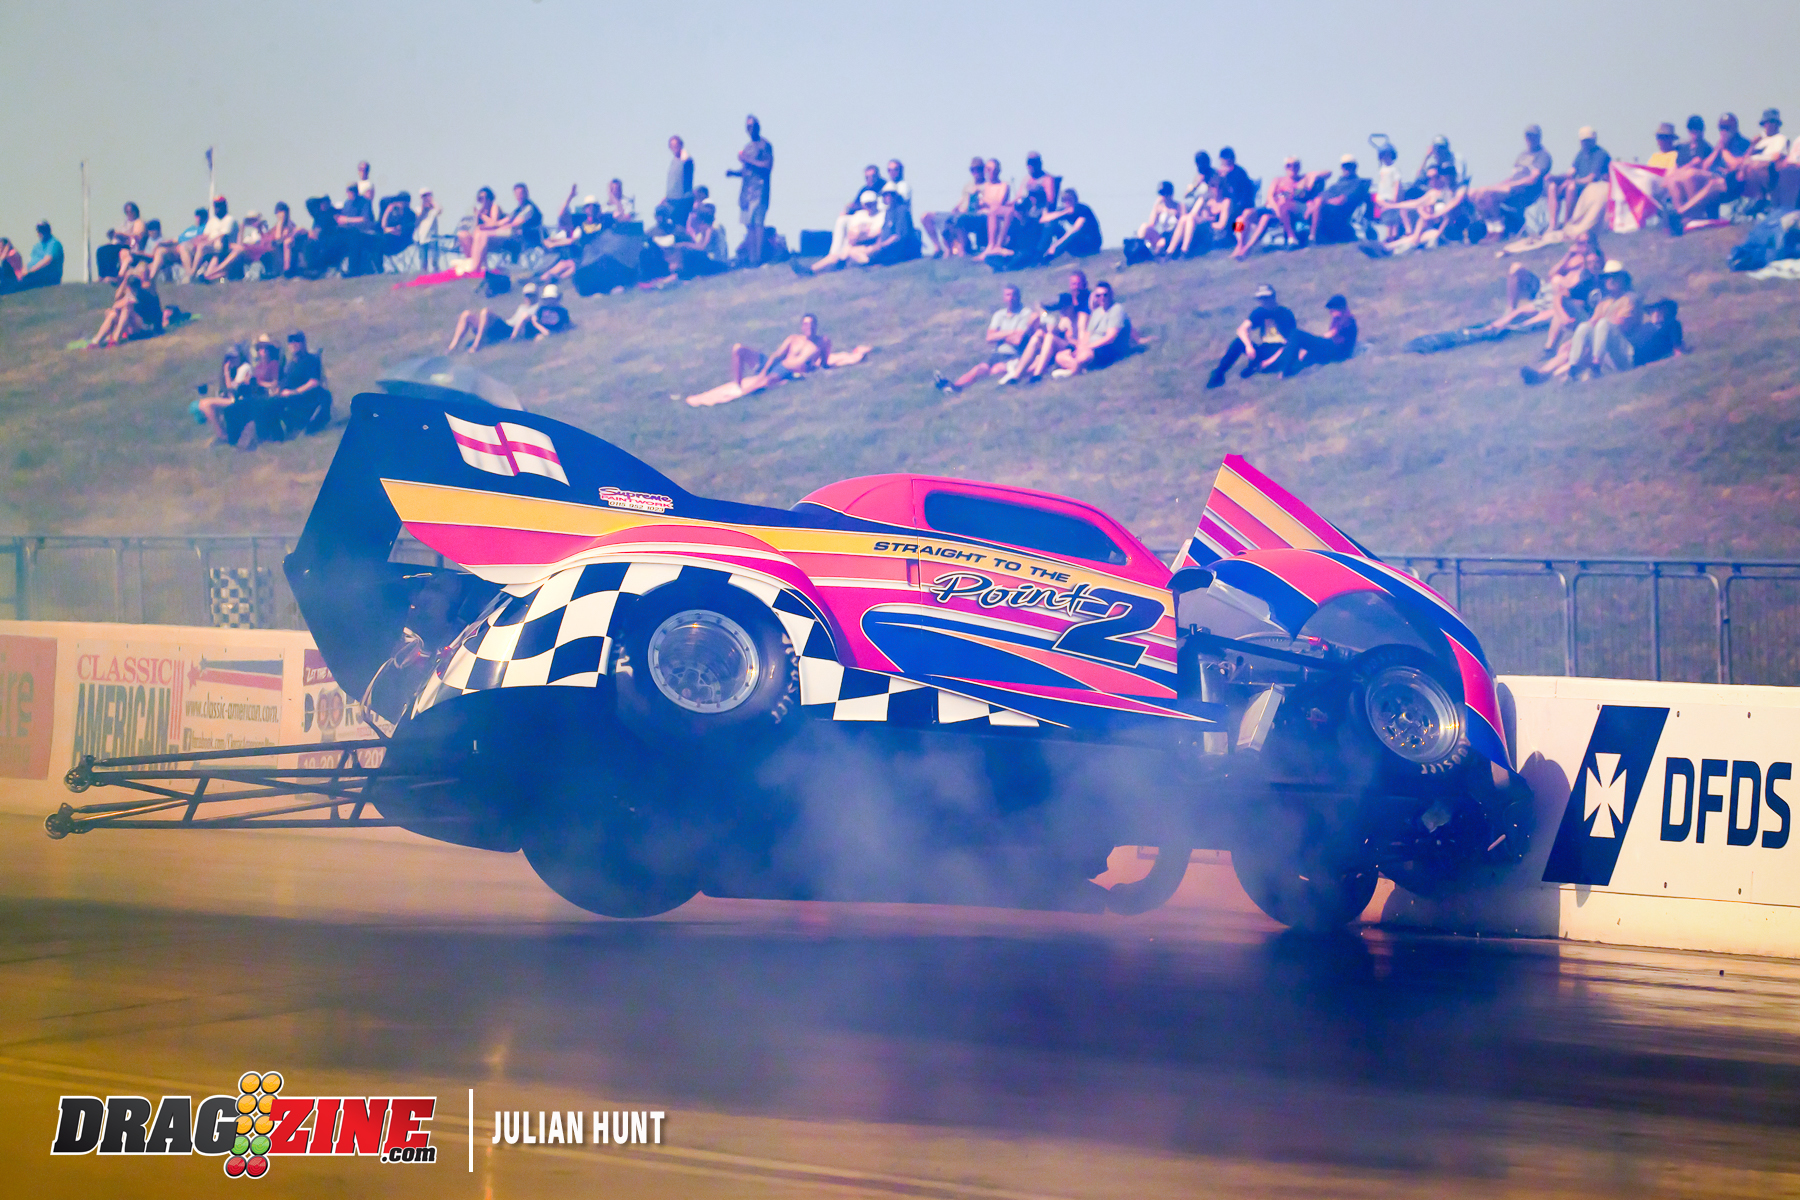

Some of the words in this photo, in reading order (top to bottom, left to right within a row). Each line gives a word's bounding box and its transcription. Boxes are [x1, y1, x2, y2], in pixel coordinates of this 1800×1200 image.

[601, 495, 674, 508] PAINTWORK
[874, 541, 987, 563] STRAIGHT
[994, 558, 1021, 571] TO
[1030, 566, 1071, 583] THE
[929, 570, 1109, 617] Point
[1052, 587, 1167, 669] 2
[77, 653, 172, 686] CLASSIC
[71, 683, 171, 771] AMERICAN
[1660, 757, 1793, 849] DFDS
